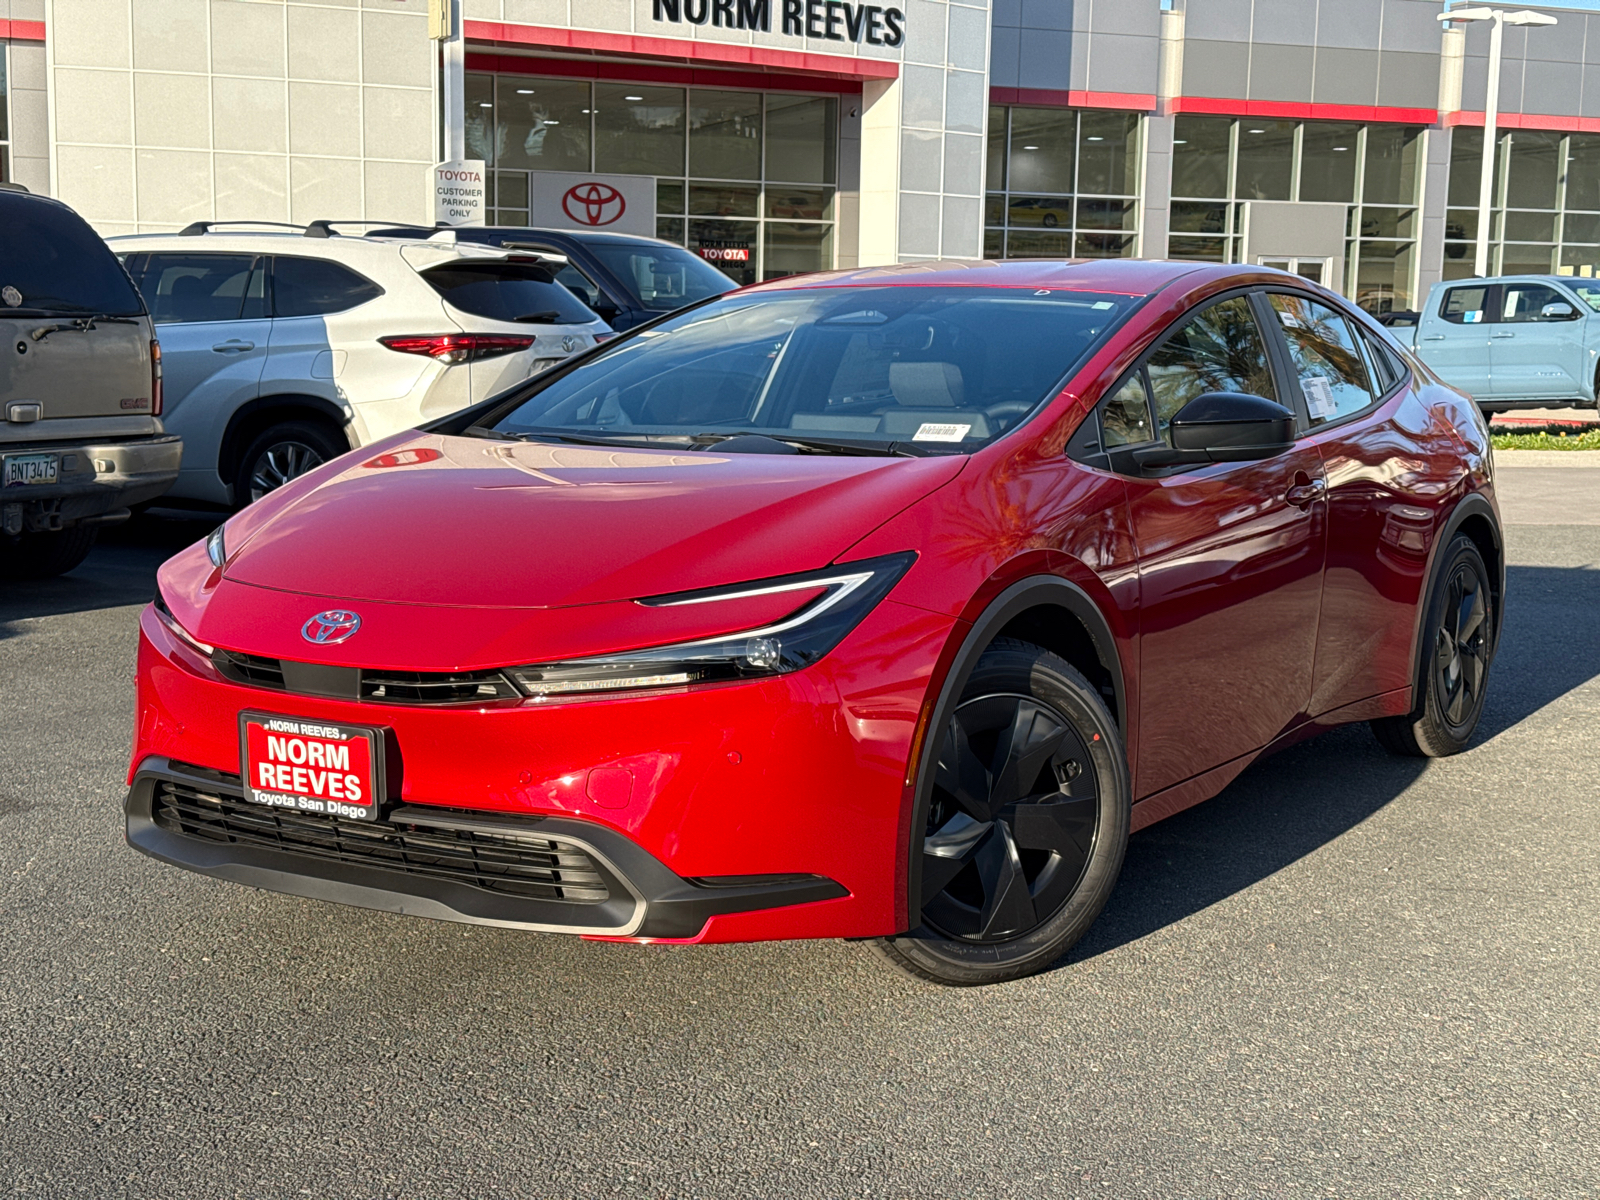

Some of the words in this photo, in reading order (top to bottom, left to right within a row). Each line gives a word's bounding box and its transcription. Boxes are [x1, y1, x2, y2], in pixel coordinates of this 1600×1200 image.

[652, 0, 772, 33] NORM
[782, 0, 905, 46] REEVES
[437, 170, 481, 182] TOYOTA
[437, 187, 482, 197] CUSTOMER
[442, 198, 478, 207] PARKING
[449, 209, 471, 217] ONLY
[699, 239, 722, 248] NORM
[723, 240, 749, 249] REEVES
[702, 249, 746, 260] TOYOTA
[721, 260, 745, 268] DIEGO
[11, 461, 56, 481] BNT3475
[269, 719, 300, 734] NORM
[301, 724, 340, 739] REEVES
[267, 735, 350, 771] NORM
[258, 762, 362, 801] REEVES
[251, 789, 296, 807] Toyota
[298, 796, 324, 812] San
[327, 800, 367, 819] Diego
